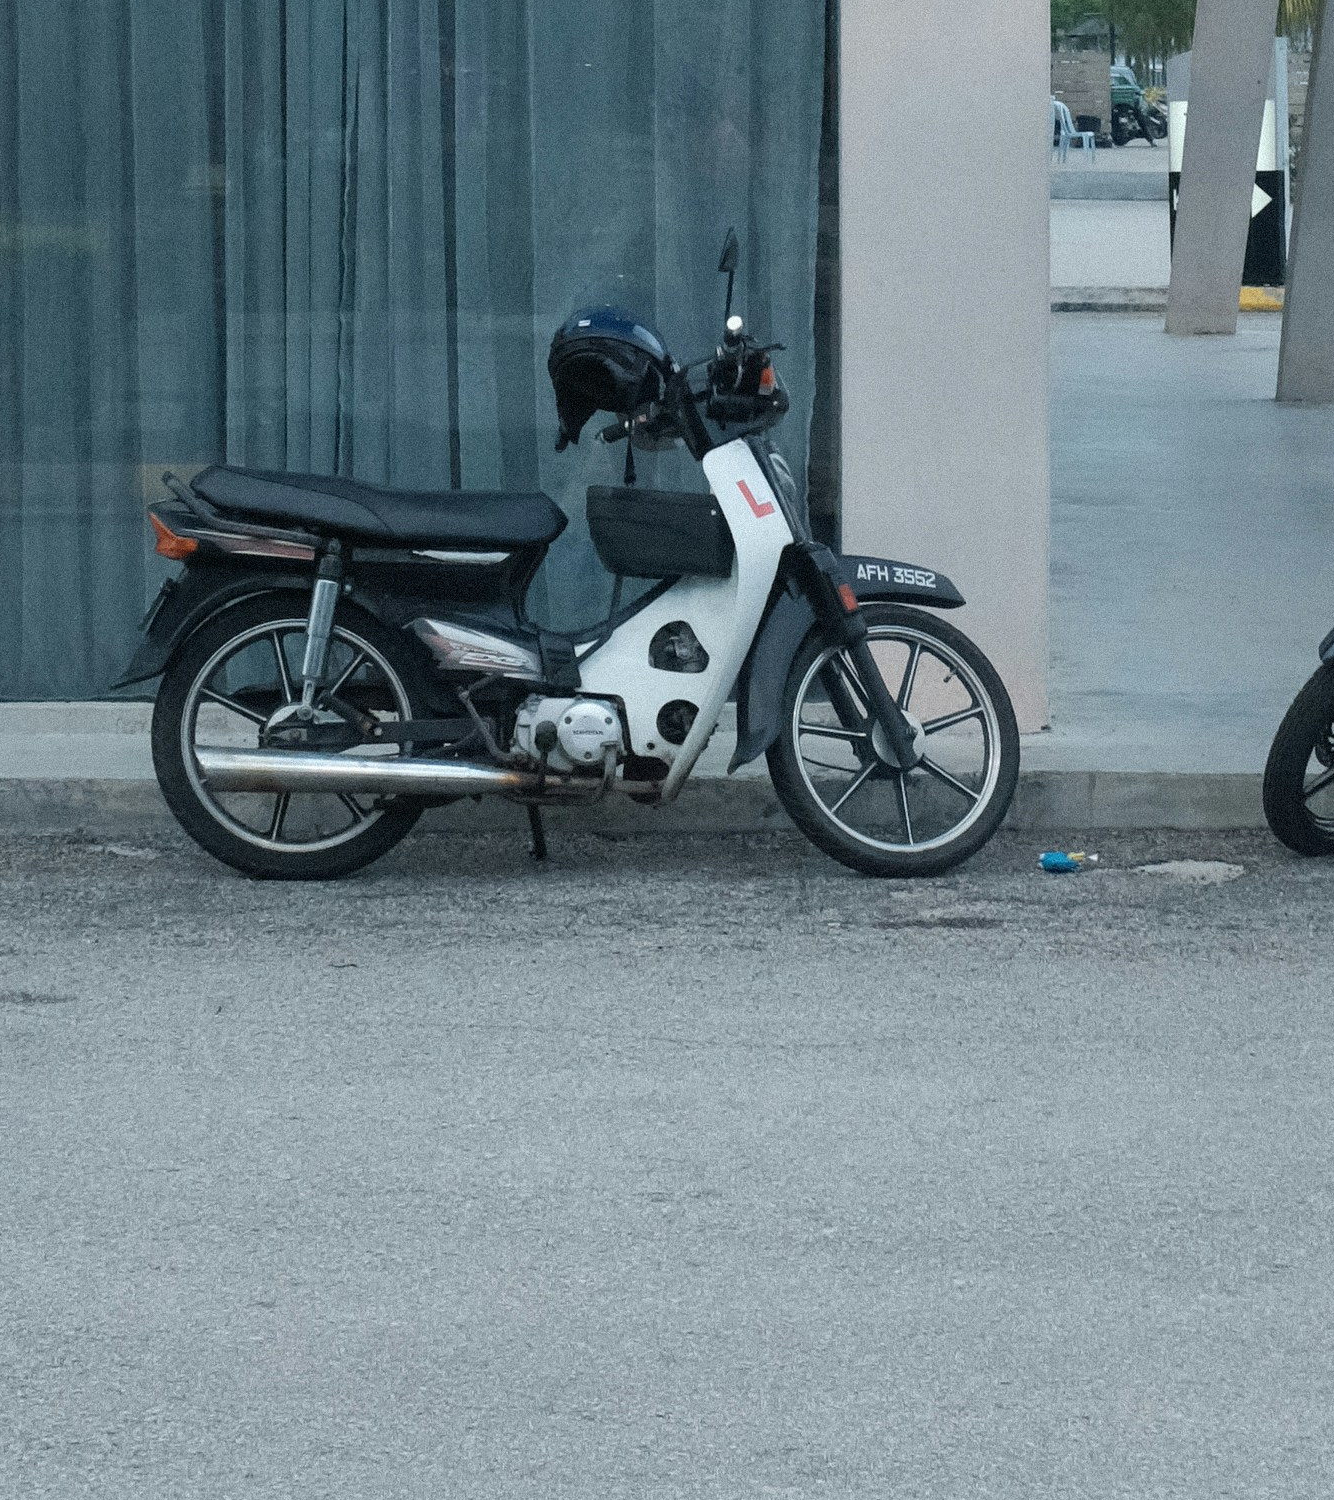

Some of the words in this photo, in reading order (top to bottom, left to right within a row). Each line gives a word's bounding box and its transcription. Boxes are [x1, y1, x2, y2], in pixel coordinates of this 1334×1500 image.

[736, 479, 775, 519] L
[857, 564, 888, 582] AFH
[893, 567, 936, 588] 3552
